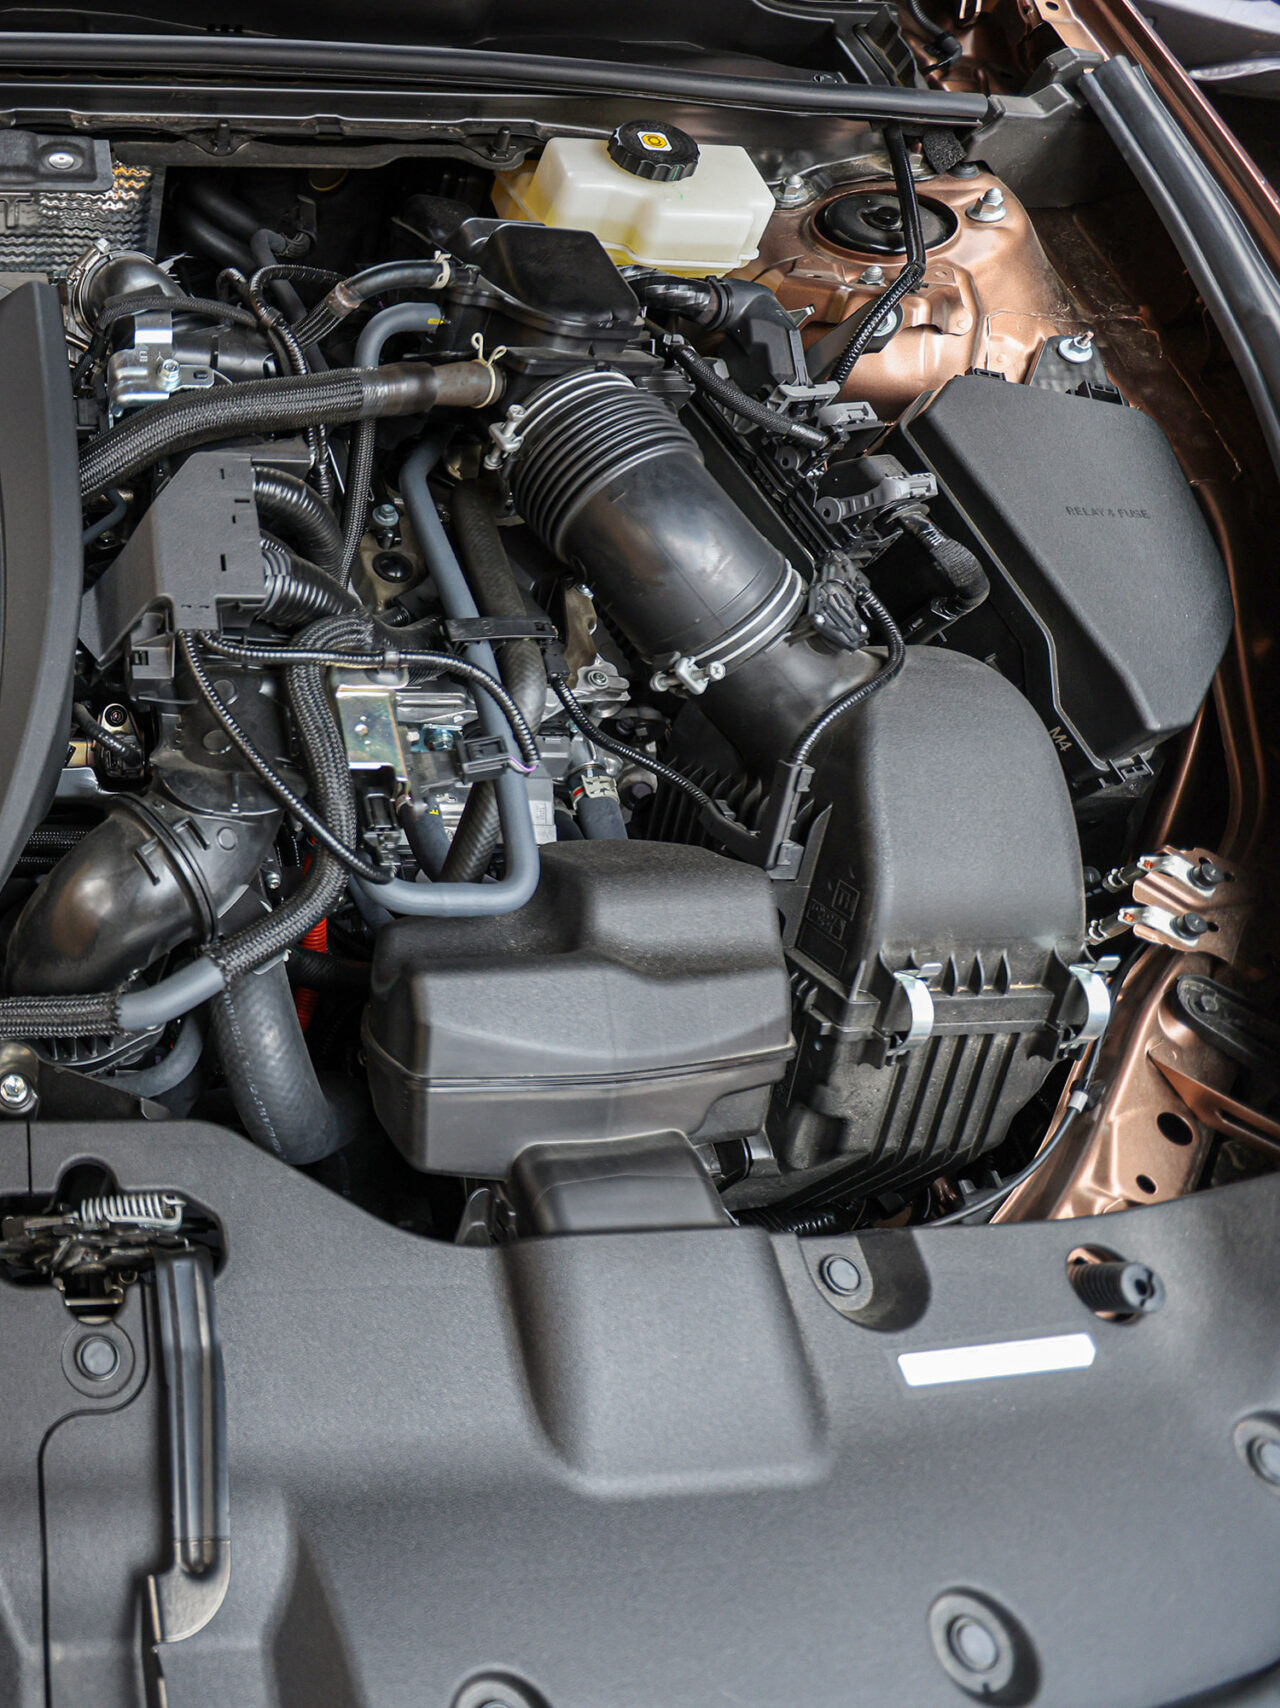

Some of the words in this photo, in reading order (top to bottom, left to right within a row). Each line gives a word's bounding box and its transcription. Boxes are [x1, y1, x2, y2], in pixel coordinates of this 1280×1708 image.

[1065, 505, 1106, 517] RELAY
[1117, 508, 1151, 520] FUSE
[1049, 726, 1072, 753] M4
